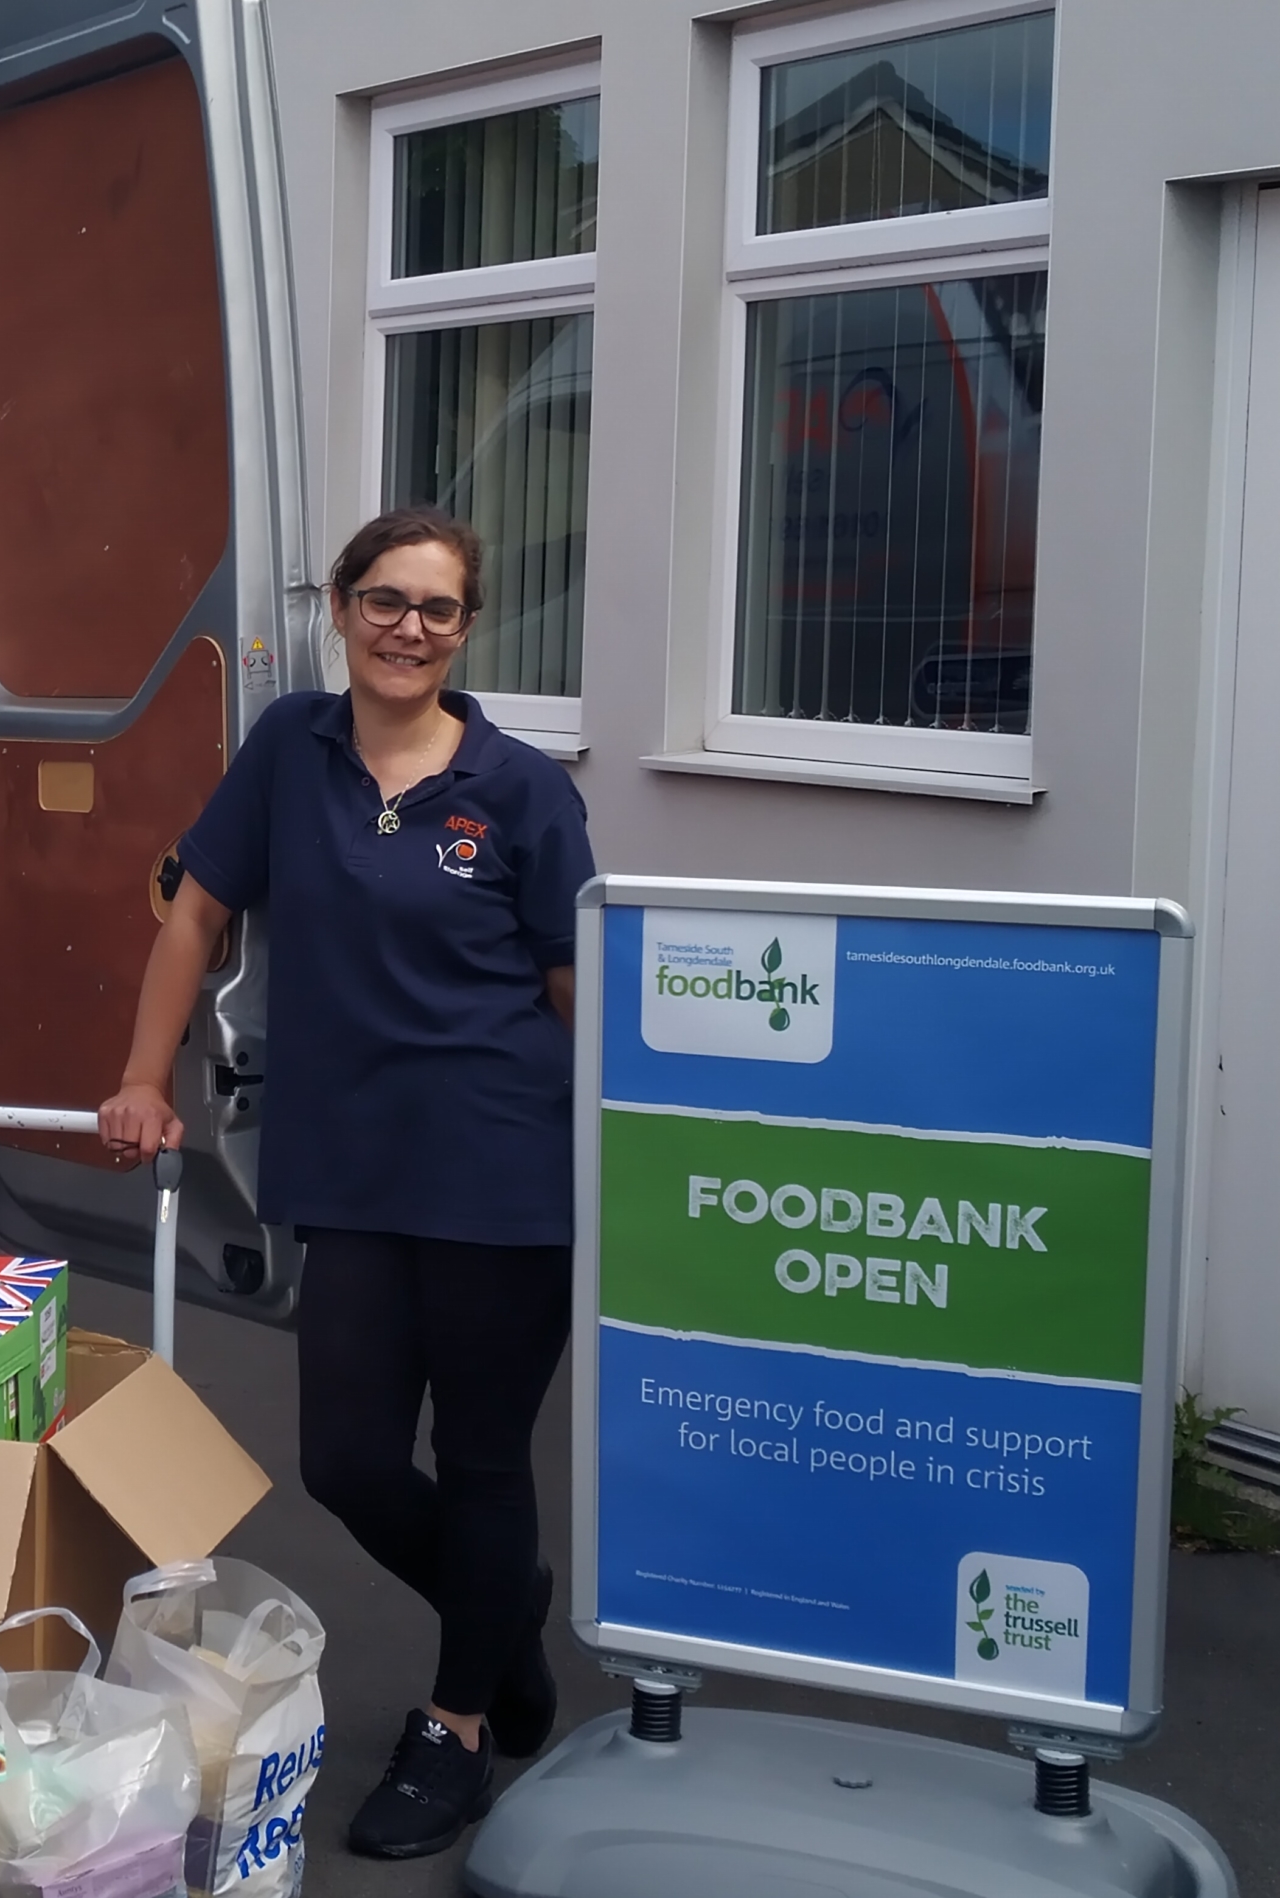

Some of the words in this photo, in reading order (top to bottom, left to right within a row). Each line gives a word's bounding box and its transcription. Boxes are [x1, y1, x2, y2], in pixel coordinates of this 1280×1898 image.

[444, 815, 487, 839] APEX
[657, 942, 703, 954] Tameside
[705, 945, 733, 955] South
[668, 954, 732, 967] Longdendale
[846, 951, 1115, 977] tamesidesouthlongdendale.foodbank.org.uk
[656, 965, 820, 1005] foodbank
[688, 1175, 1048, 1252] FOODBANK
[775, 1249, 948, 1308] OPEN
[641, 1378, 804, 1430] Emergency
[813, 1400, 884, 1435] food
[895, 1416, 954, 1443] and
[966, 1426, 1093, 1460] support
[678, 1422, 720, 1451] for
[731, 1428, 800, 1464] local
[810, 1448, 916, 1481] people
[926, 1456, 954, 1485] in
[966, 1465, 1046, 1496] crisis
[1004, 1593, 1039, 1614] the
[1004, 1611, 1079, 1638] trussell
[1004, 1629, 1052, 1651] trust
